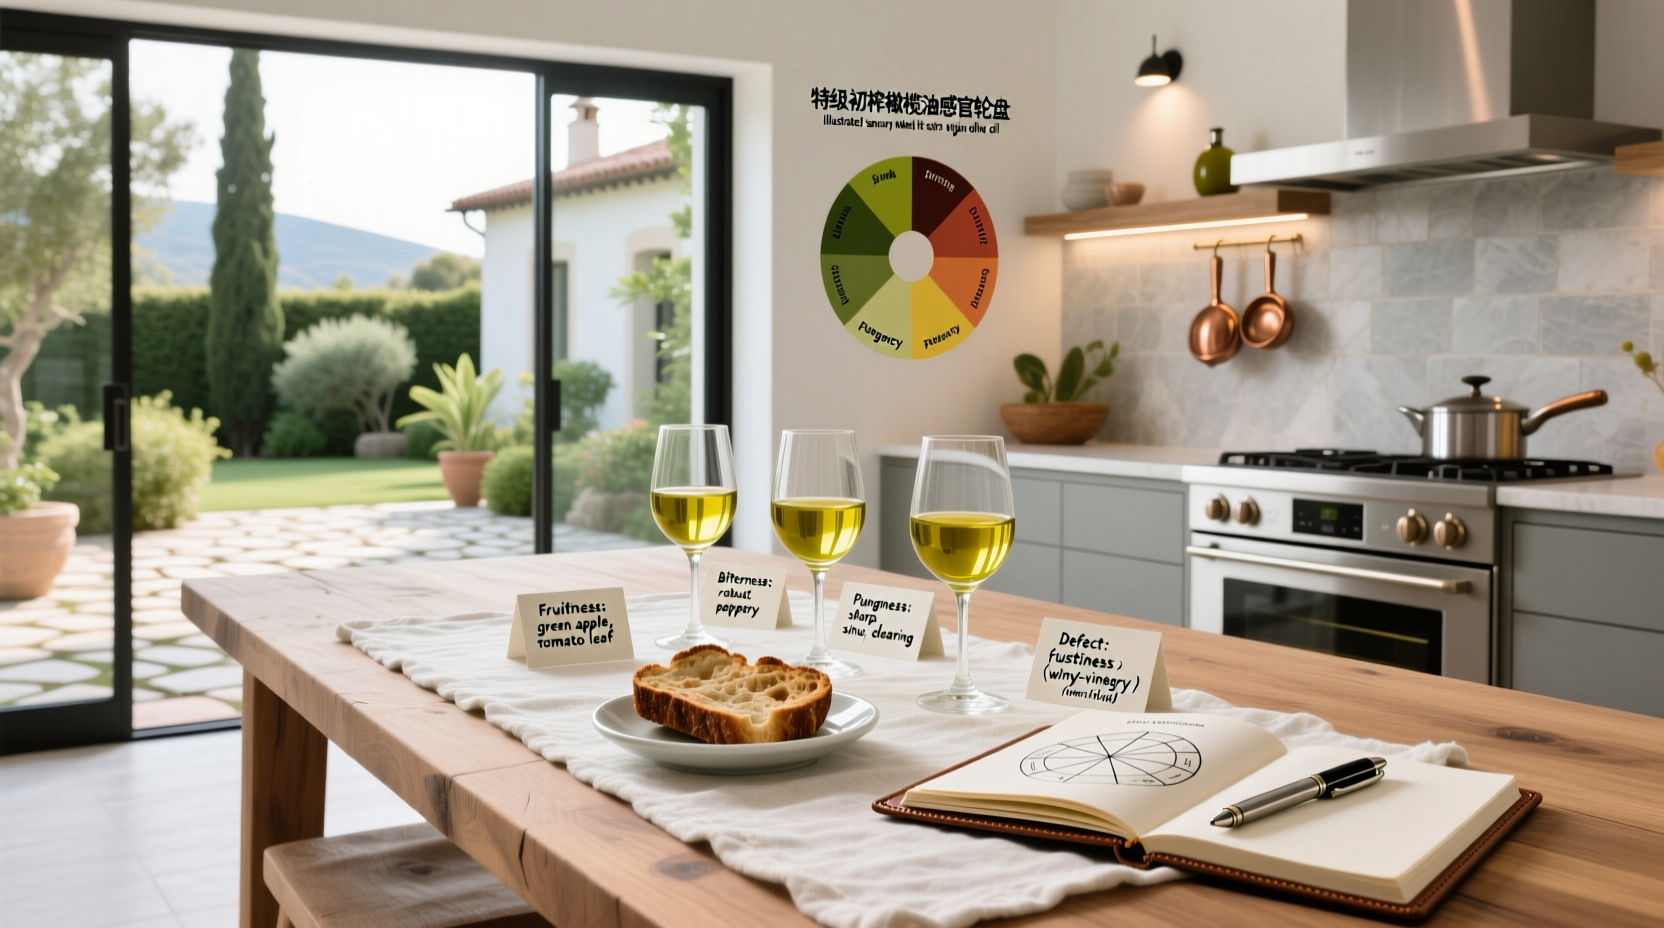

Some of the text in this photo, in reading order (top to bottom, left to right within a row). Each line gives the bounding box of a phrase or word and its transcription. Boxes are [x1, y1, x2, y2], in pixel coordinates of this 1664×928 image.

[539, 601, 606, 616] Fruitness:
[537, 621, 571, 636] green
[871, 623, 914, 648] clearing
[537, 629, 614, 648] tomato leaf
[1059, 632, 1109, 651] Defect:
